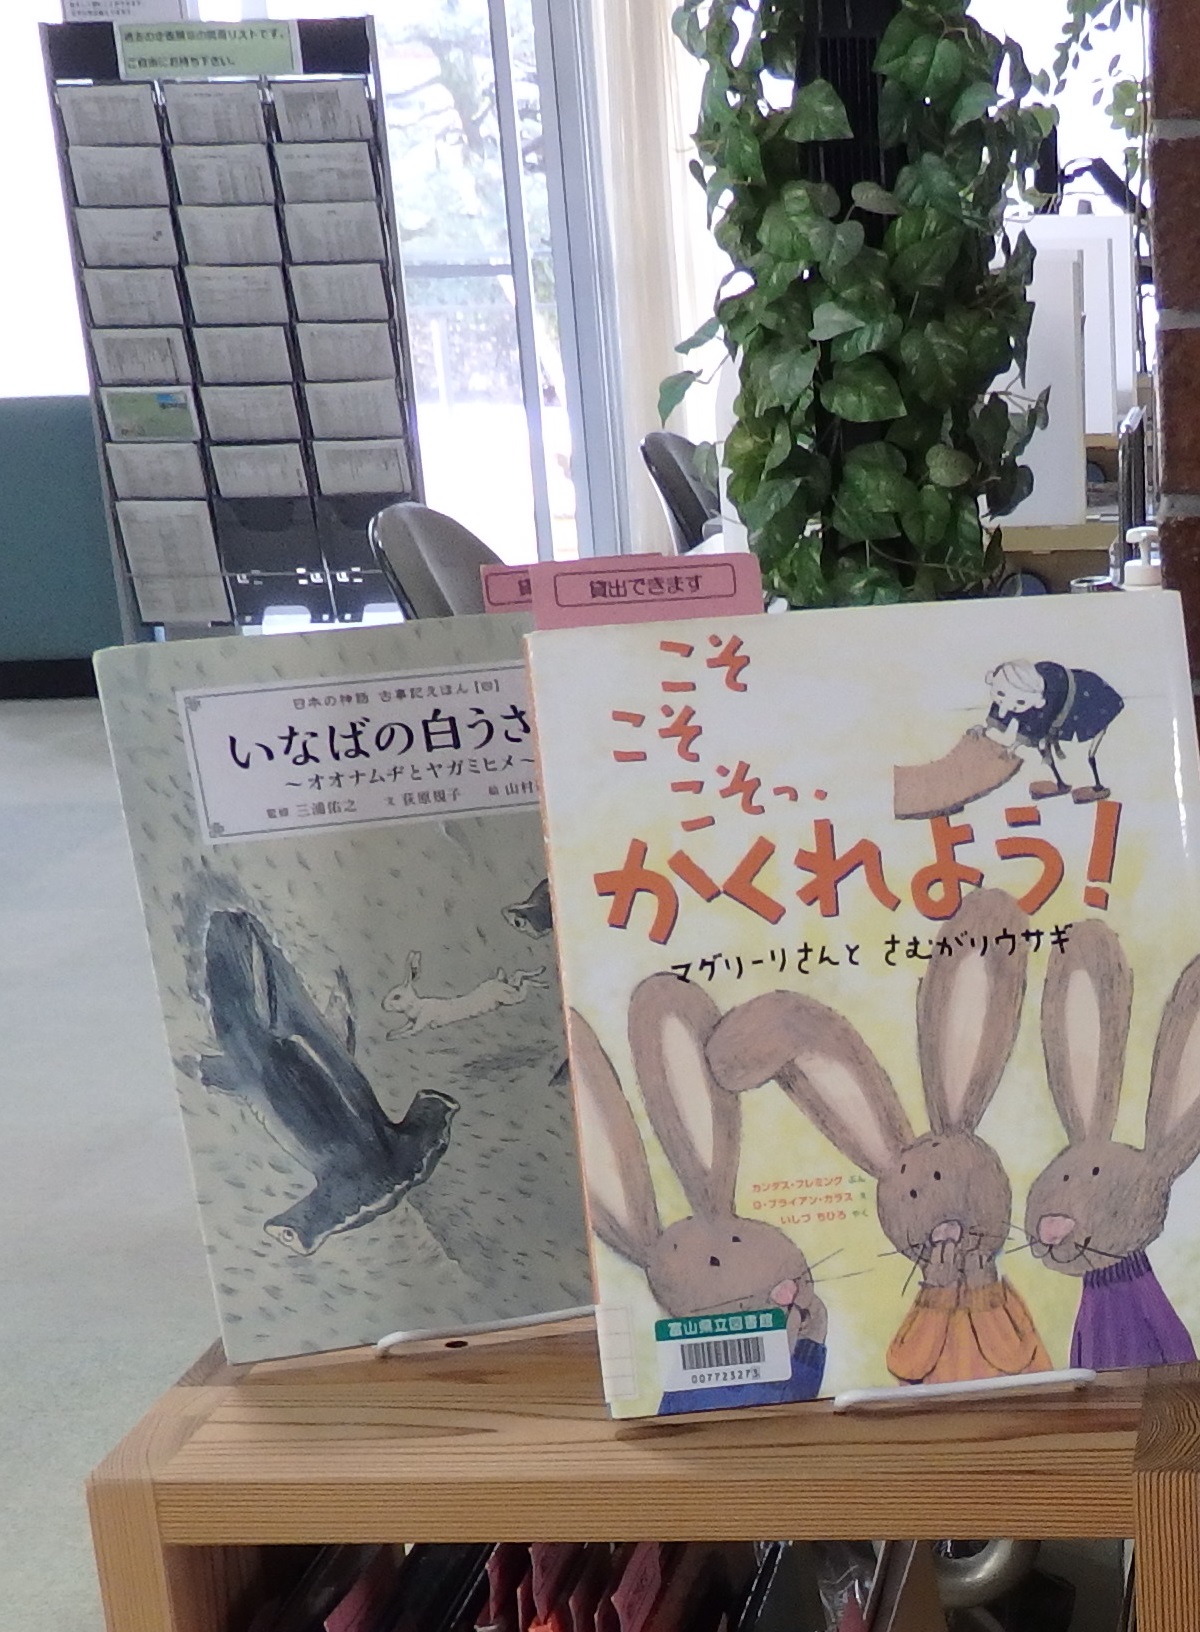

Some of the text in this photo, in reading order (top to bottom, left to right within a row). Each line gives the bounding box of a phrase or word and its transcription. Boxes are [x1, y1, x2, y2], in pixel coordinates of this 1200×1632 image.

[589, 571, 703, 601] 貸出できます
[659, 634, 752, 693] こそ
[612, 706, 703, 764] こそ
[594, 801, 1123, 946] かくれよう!
[671, 923, 1073, 984] マグリーリさんと さむがりウサギ
[667, 1313, 774, 1337] 富山県立図書館
